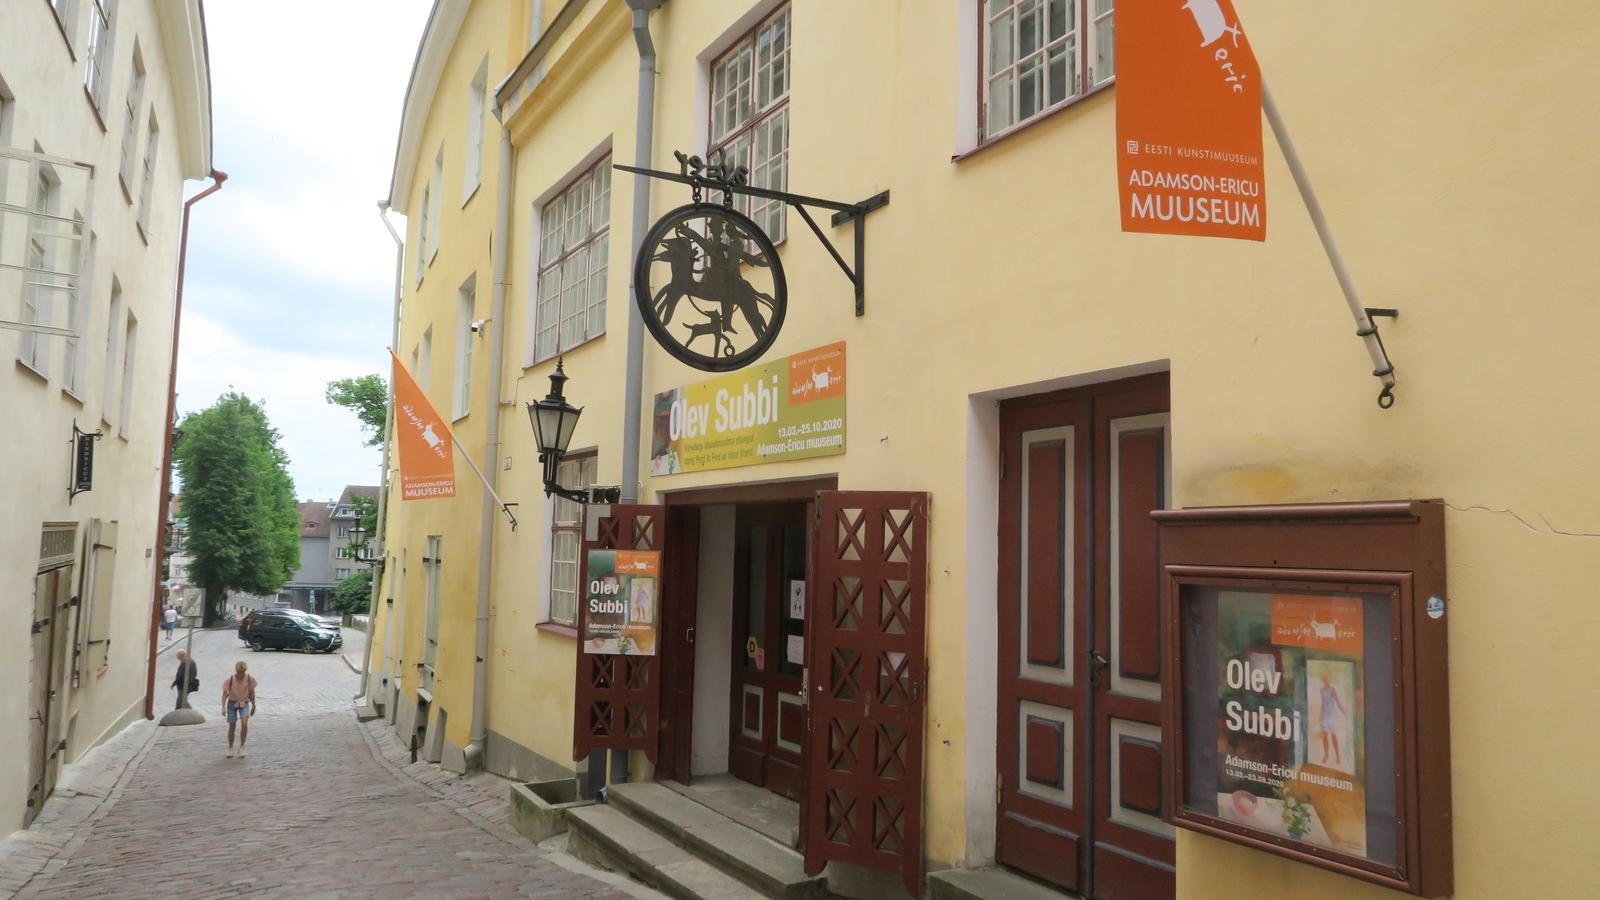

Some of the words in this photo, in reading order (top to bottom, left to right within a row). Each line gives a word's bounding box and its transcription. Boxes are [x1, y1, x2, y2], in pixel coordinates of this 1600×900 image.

[1145, 143, 1172, 156] EESTI
[1177, 147, 1258, 166] KUNSTIMUUSEUM
[1129, 169, 1259, 197] ADAMSON-ERICU
[1131, 192, 1260, 228] MUUSEUM
[669, 397, 709, 442] Olev
[715, 375, 778, 433] Subbi
[757, 437, 805, 456] Adamson-Ericu
[806, 433, 842, 450] muuseum
[404, 480, 454, 489] ADAMSON-ERICU
[405, 486, 454, 497] MUUSEUM
[591, 580, 620, 595] Olev
[590, 599, 628, 614] Subbi
[1227, 659, 1281, 694] Olev
[1226, 700, 1300, 742] Subbi
[1225, 754, 1297, 780] Adamson-Ericu
[1300, 770, 1353, 791] muuseum
